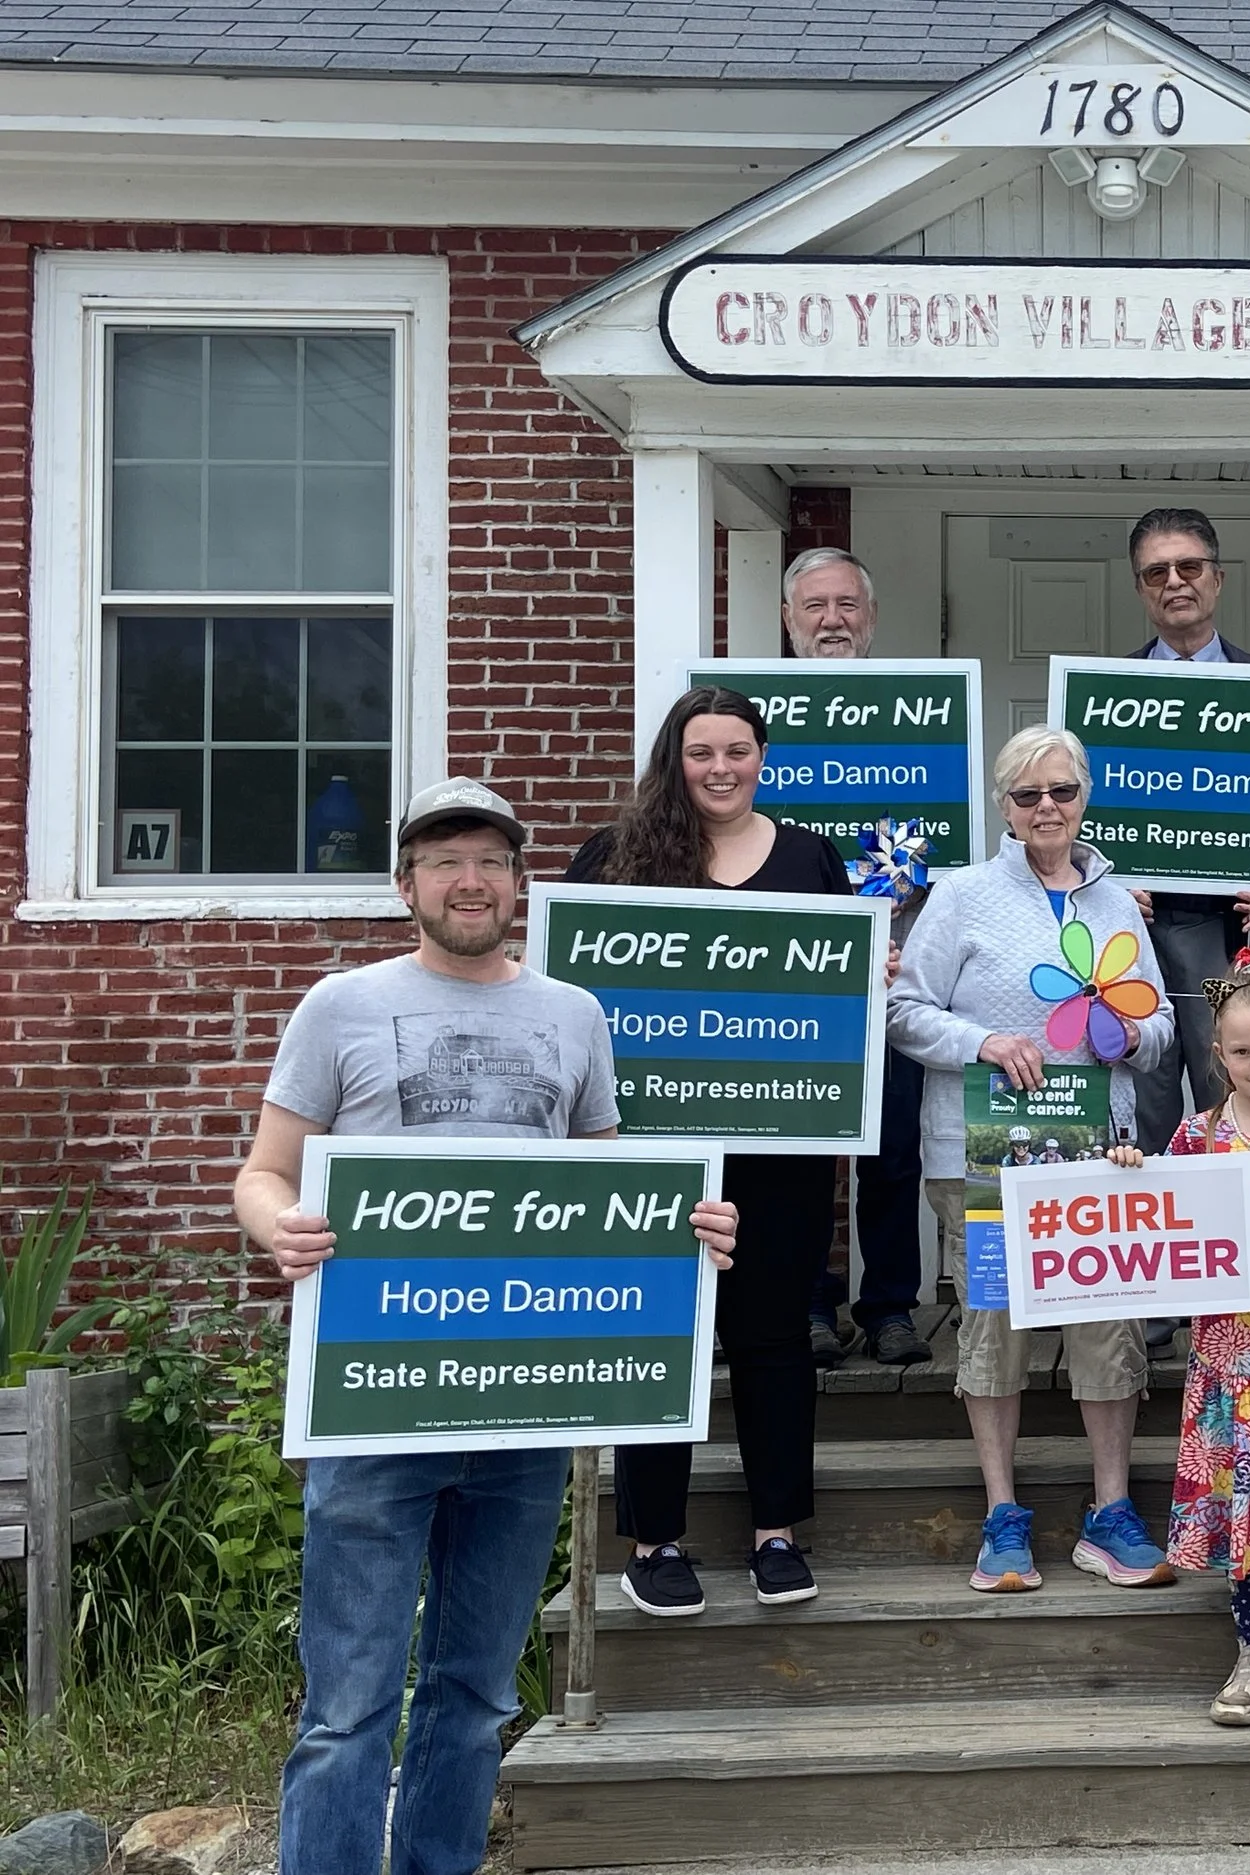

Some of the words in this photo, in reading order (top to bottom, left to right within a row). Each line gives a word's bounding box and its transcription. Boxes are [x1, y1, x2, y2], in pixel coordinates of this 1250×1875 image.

[1040, 80, 1184, 137] 1780
[716, 291, 1000, 348] CROYDON
[824, 695, 880, 727] for
[893, 696, 951, 726] NH
[1083, 696, 1185, 731] HOPE
[758, 766, 814, 790] ope
[823, 760, 927, 785] Damon
[1105, 763, 1183, 796] Hope
[127, 823, 170, 861] A7
[1080, 820, 1138, 843] State
[569, 929, 691, 968] HOPE
[706, 934, 769, 971] for
[784, 938, 853, 973] NH
[606, 1007, 688, 1043] Hope
[699, 1009, 820, 1041] Damon
[645, 1074, 842, 1104] Representative
[1027, 1090, 1044, 1102] to
[1045, 1088, 1075, 1102] end
[1049, 1075, 1071, 1089] all
[1072, 1074, 1087, 1089] in
[421, 1098, 480, 1115] CROYDO
[1027, 1104, 1086, 1116] cancer.
[352, 1190, 495, 1231] HOPE
[513, 1190, 586, 1233] for
[604, 1192, 683, 1232] NH
[1028, 1191, 1194, 1240] #GIRL
[1032, 1238, 1241, 1291] POWER
[381, 1279, 490, 1321] Hope
[503, 1279, 643, 1313] Damon
[343, 1361, 427, 1390] State
[438, 1355, 668, 1392] Representative
